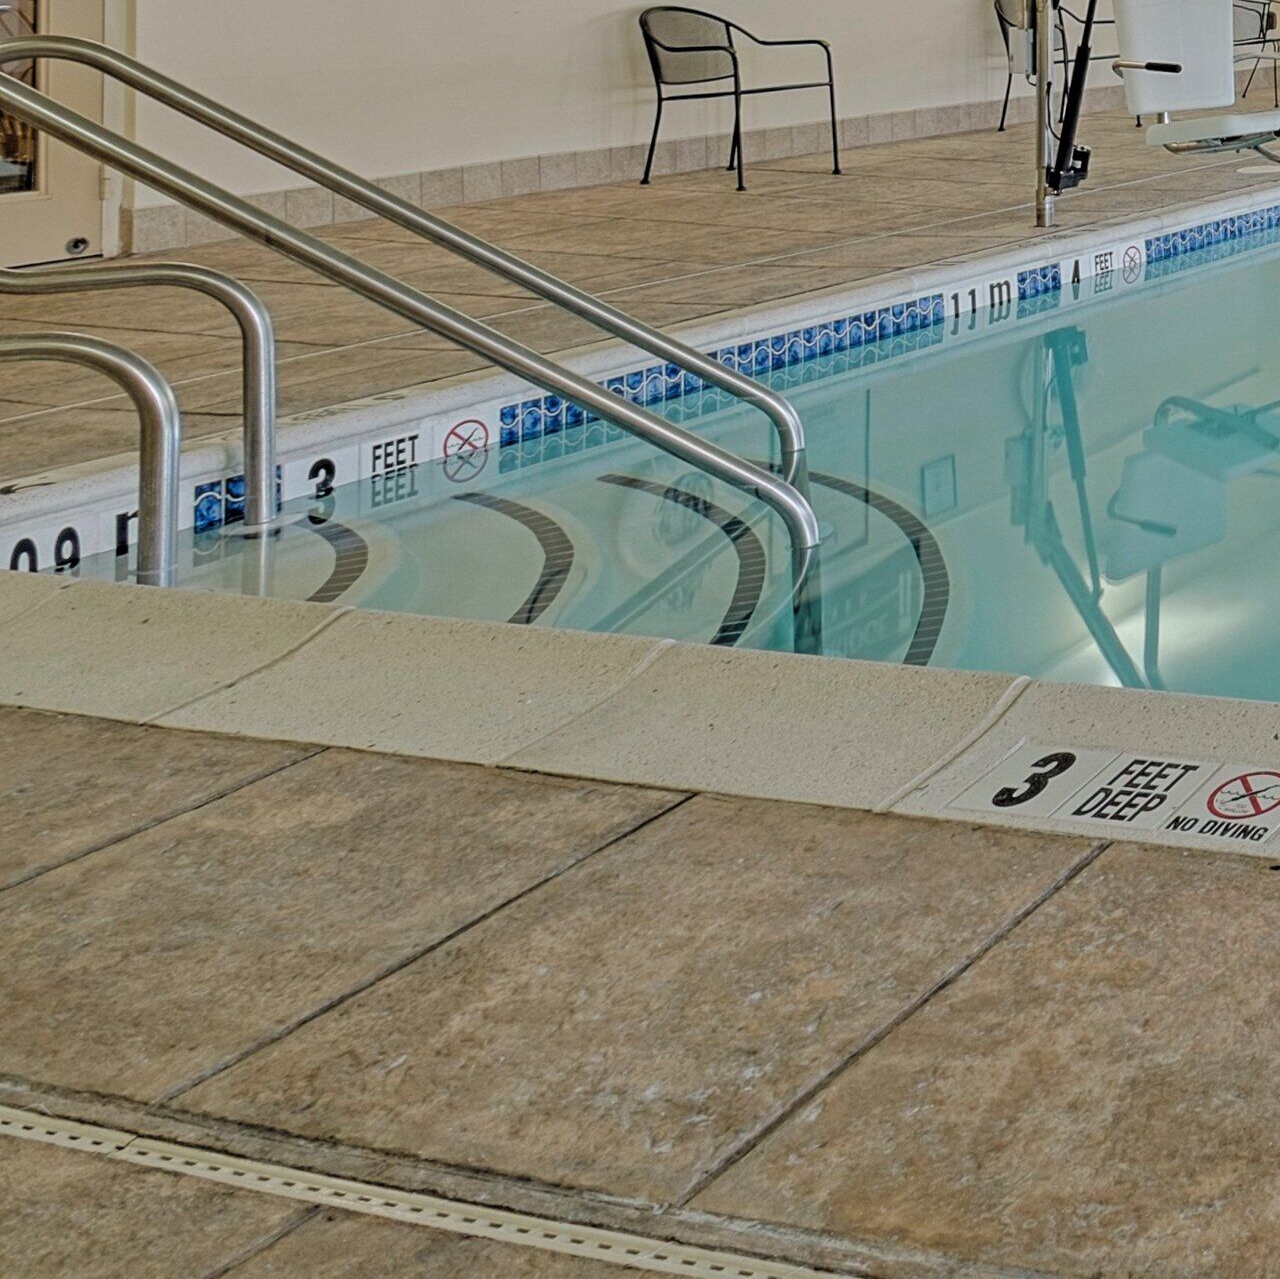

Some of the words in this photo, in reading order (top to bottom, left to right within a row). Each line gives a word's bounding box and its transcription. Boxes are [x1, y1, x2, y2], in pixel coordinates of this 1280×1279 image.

[1094, 251, 1114, 272] FEET
[308, 458, 336, 500] 3
[371, 434, 419, 473] FEET
[992, 752, 1077, 808] 3
[1107, 758, 1200, 792] FEET
[1072, 787, 1168, 822] DEEP
[1166, 816, 1199, 831] NO
[1198, 820, 1269, 842] DIVING
